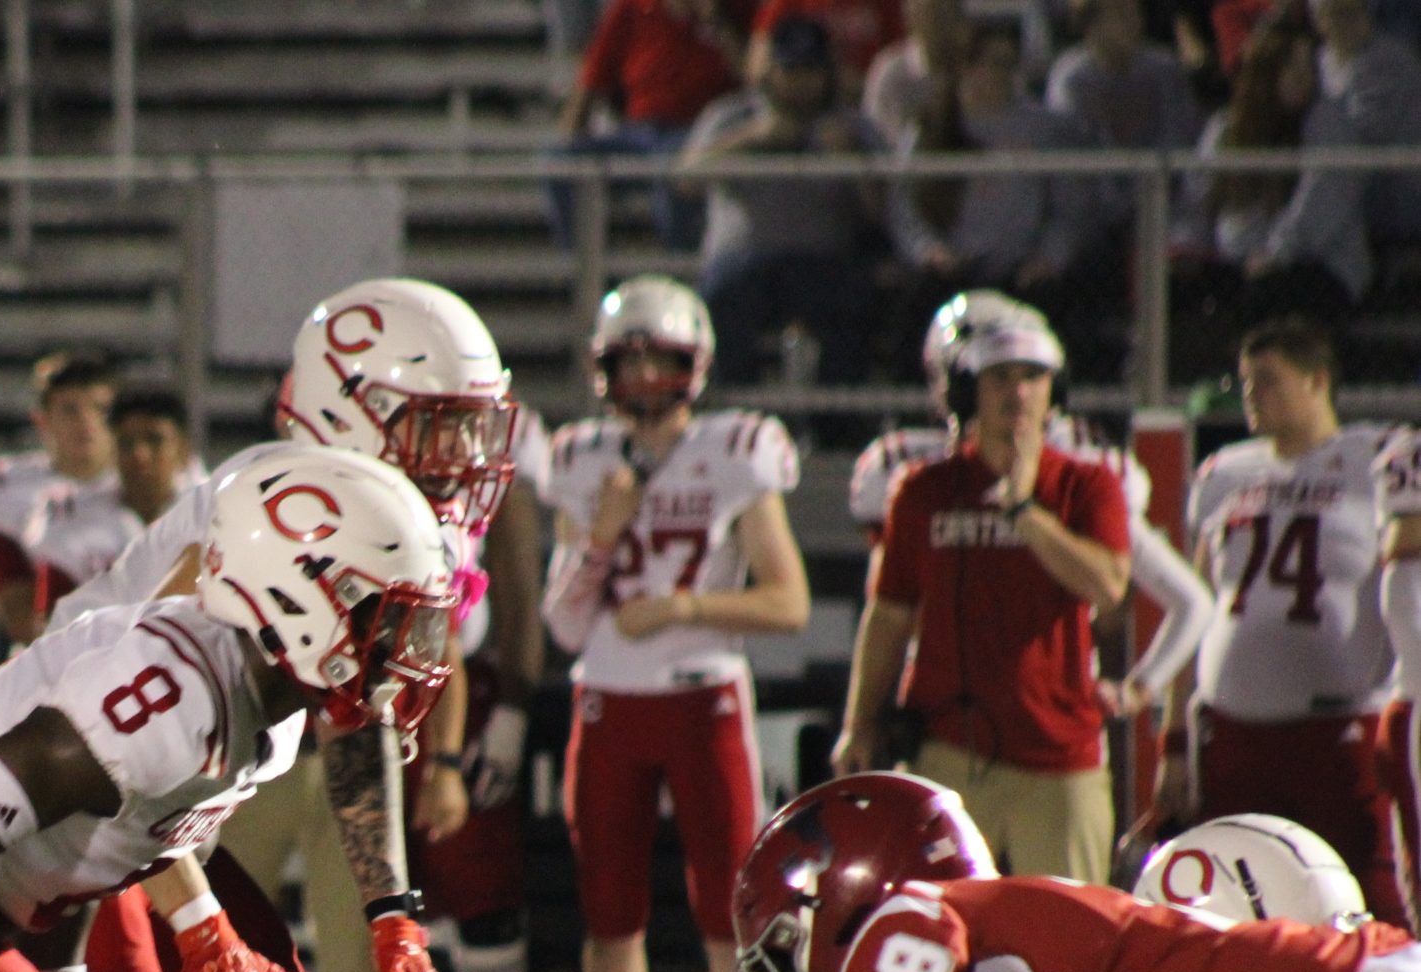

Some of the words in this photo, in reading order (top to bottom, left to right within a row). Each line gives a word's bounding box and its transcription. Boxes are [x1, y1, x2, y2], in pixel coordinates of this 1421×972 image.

[263, 485, 342, 542] C
[1223, 514, 1324, 623] 74
[101, 664, 183, 735] 8
